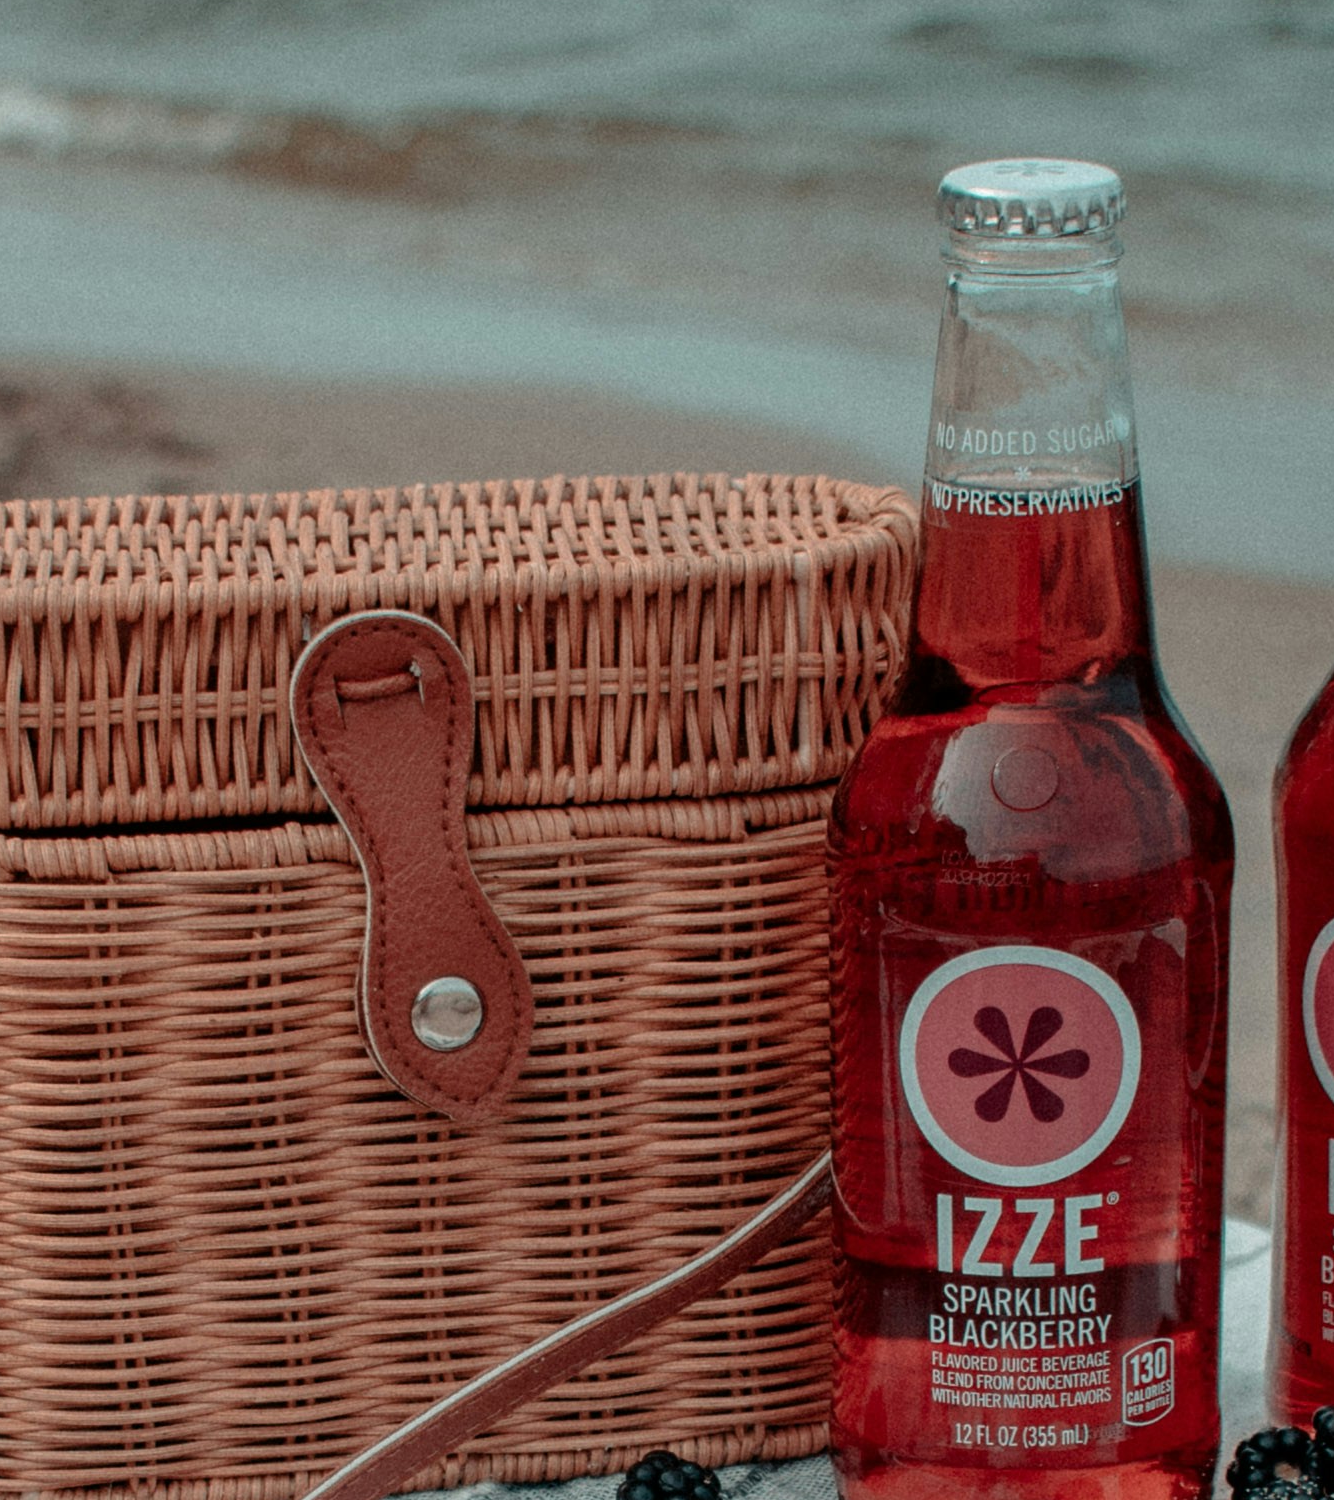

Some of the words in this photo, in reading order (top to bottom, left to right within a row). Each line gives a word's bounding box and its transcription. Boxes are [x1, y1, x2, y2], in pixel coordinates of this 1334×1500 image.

[936, 422, 955, 449] NO
[961, 428, 1037, 456] ADDED
[932, 482, 952, 510] NO
[956, 480, 1124, 516] PRESERVATIVES
[943, 1283, 1097, 1316] SPARKLING
[929, 1314, 1112, 1350] BLACKBERRY
[932, 1351, 998, 1372] FLAVORED
[1000, 1357, 1038, 1373] JUICE
[1042, 1350, 1111, 1372] BEVERAGE
[1130, 1346, 1167, 1387] 130
[932, 1369, 974, 1388] BLEND
[976, 1374, 1014, 1390] FROM
[1017, 1369, 1111, 1391] CONCENTRATE
[1126, 1379, 1173, 1405] CALORIES
[932, 1387, 961, 1404] WITH
[962, 1391, 1001, 1408] OTHER
[1003, 1393, 1059, 1409] NATURAL
[1060, 1387, 1112, 1407] FLAVORS
[1128, 1404, 1144, 1417] PER
[1145, 1397, 1171, 1414] BOTTLE
[955, 1423, 972, 1445] 12
[977, 1425, 994, 1446] FL
[998, 1425, 1018, 1447] OZ
[1022, 1424, 1057, 1449] (355
[1061, 1423, 1090, 1446] mL)
